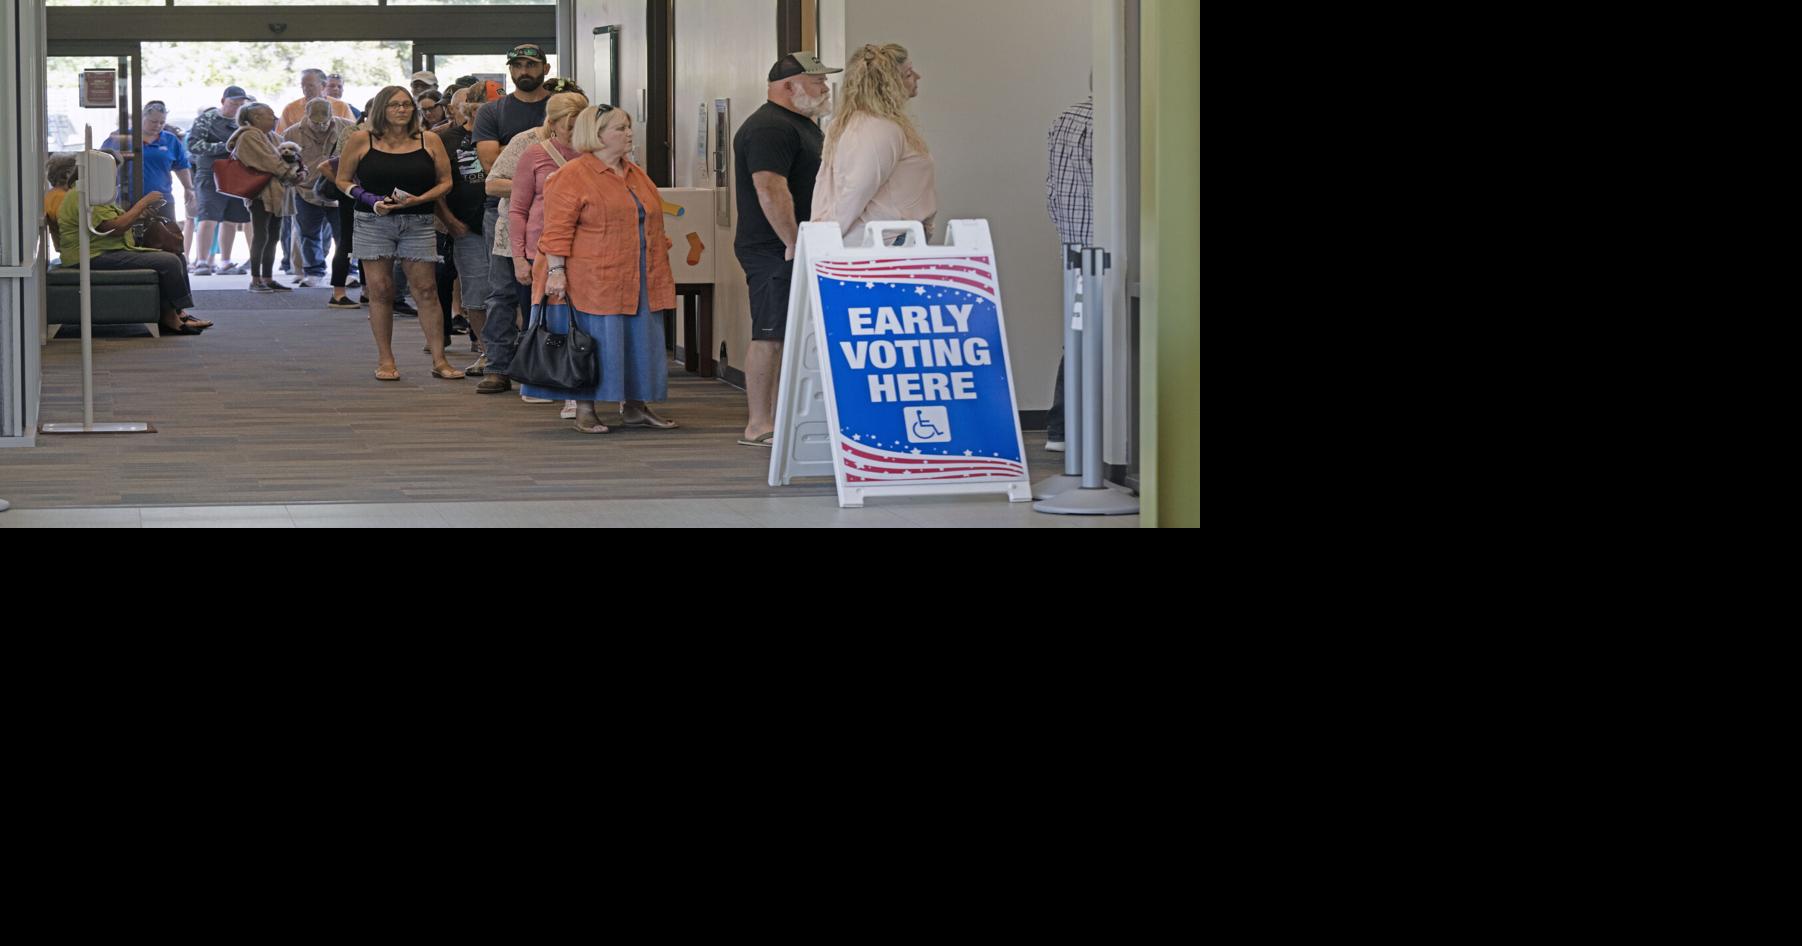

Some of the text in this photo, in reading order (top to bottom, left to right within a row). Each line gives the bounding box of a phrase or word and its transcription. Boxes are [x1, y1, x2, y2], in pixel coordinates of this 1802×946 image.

[848, 304, 974, 336] EARLY
[839, 337, 992, 370] VOTING
[867, 371, 977, 403] HERE
